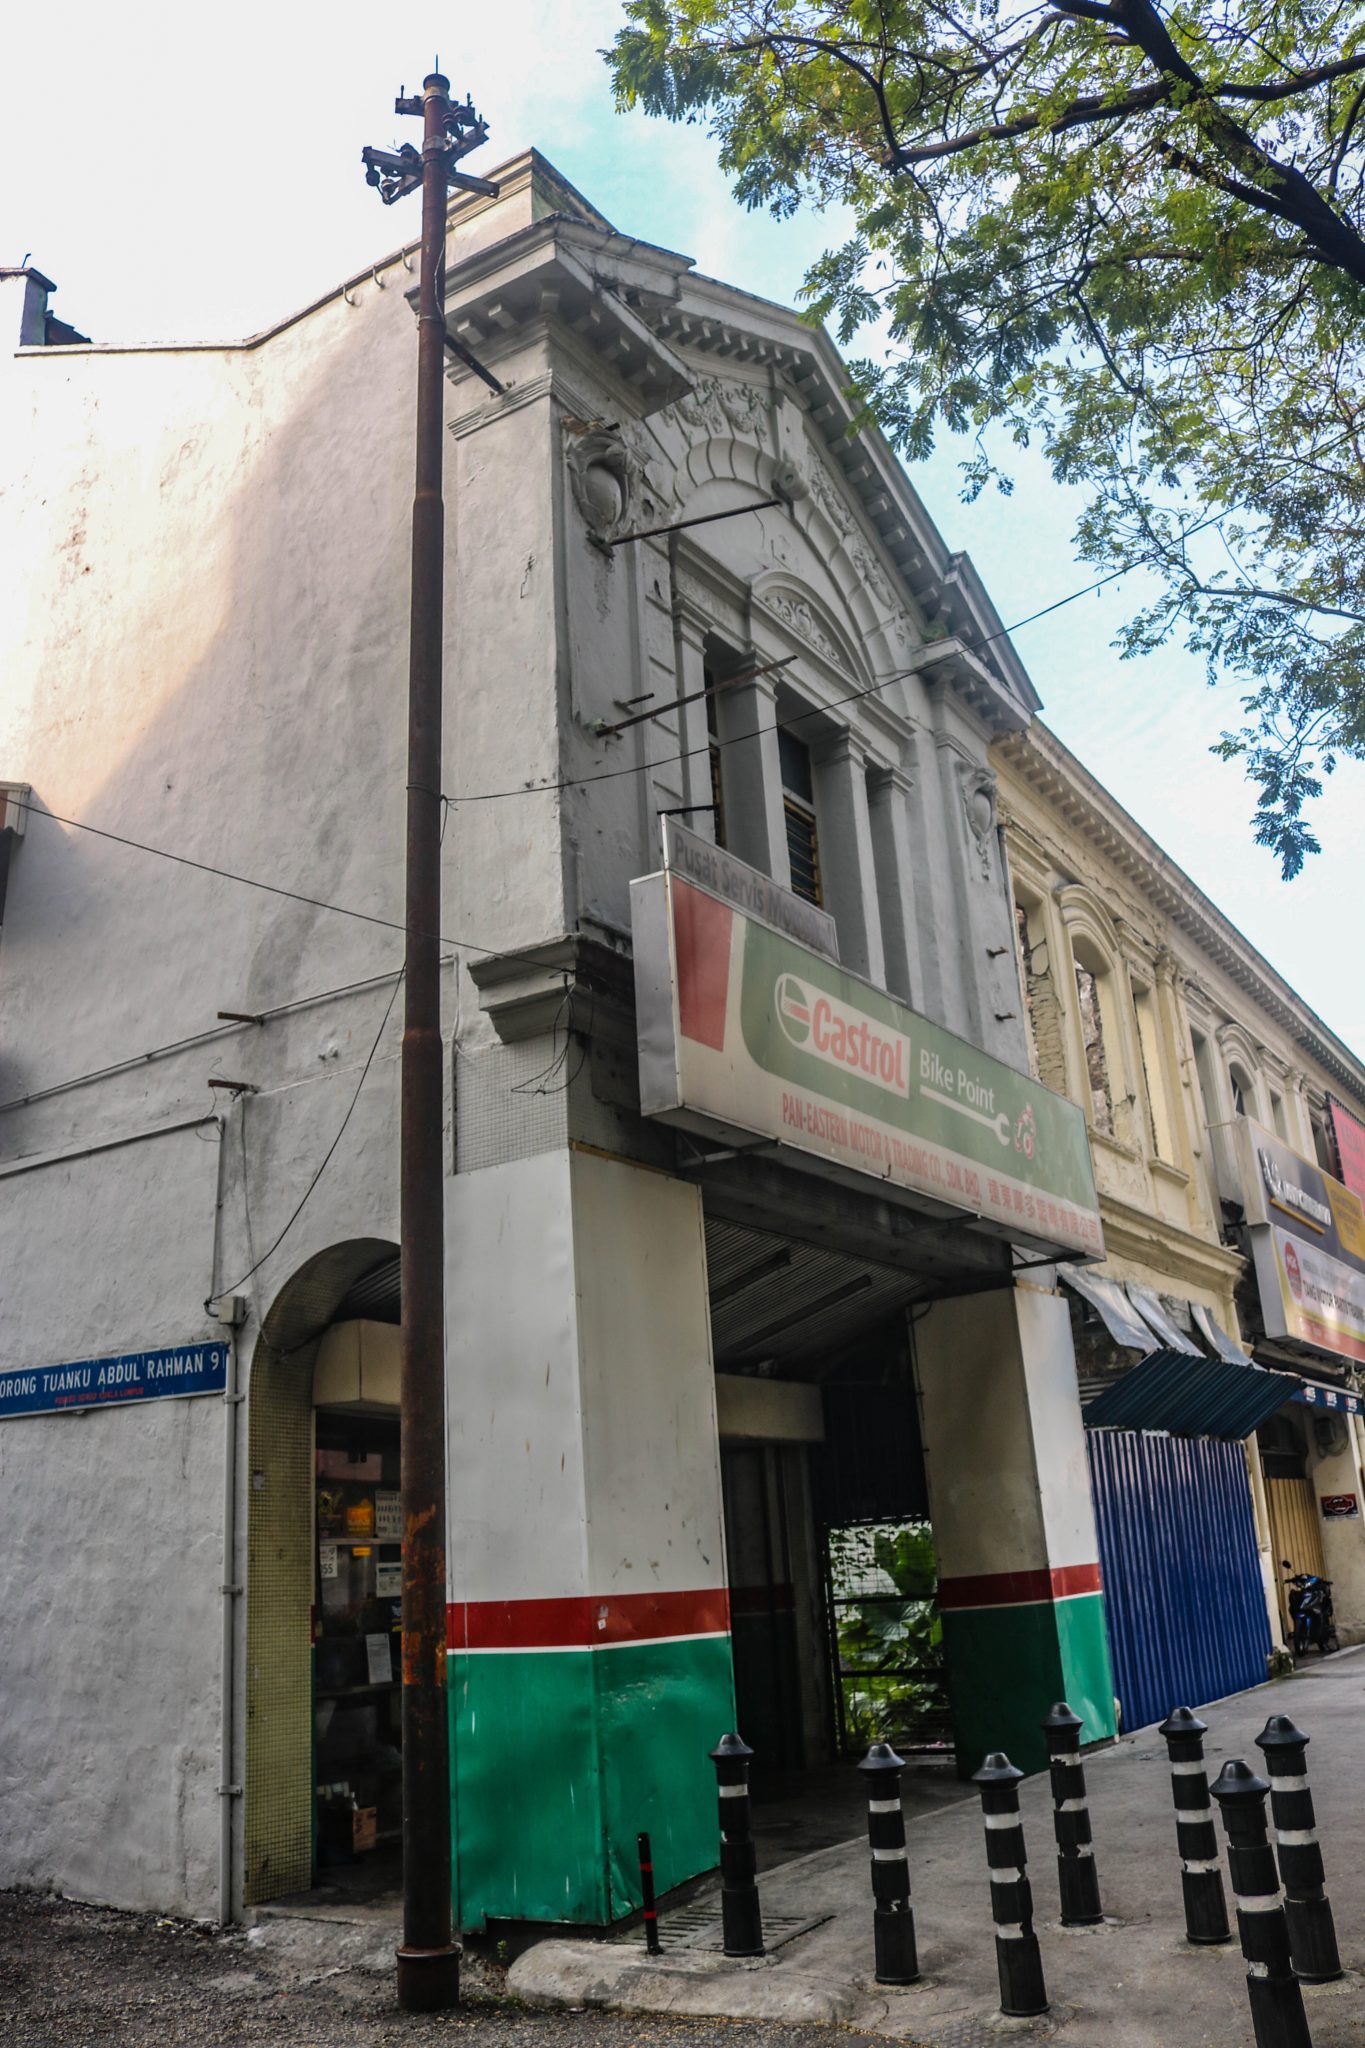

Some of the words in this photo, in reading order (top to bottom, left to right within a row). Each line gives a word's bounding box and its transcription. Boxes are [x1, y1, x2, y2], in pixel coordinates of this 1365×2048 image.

[674, 833, 718, 887] Pusat
[721, 861, 765, 911] Servis
[812, 998, 905, 1089] Castrol
[919, 1048, 954, 1092] Bike
[957, 1068, 995, 1113] Point
[782, 1092, 848, 1147] PAN-EASTERN
[850, 1122, 882, 1160] MOTOR
[891, 1138, 929, 1178] TRADING
[43, 1369, 91, 1392] TUANKU
[97, 1363, 141, 1385] ABDUL
[147, 1353, 203, 1379] RAHMAN
[210, 1352, 219, 1370] 9
